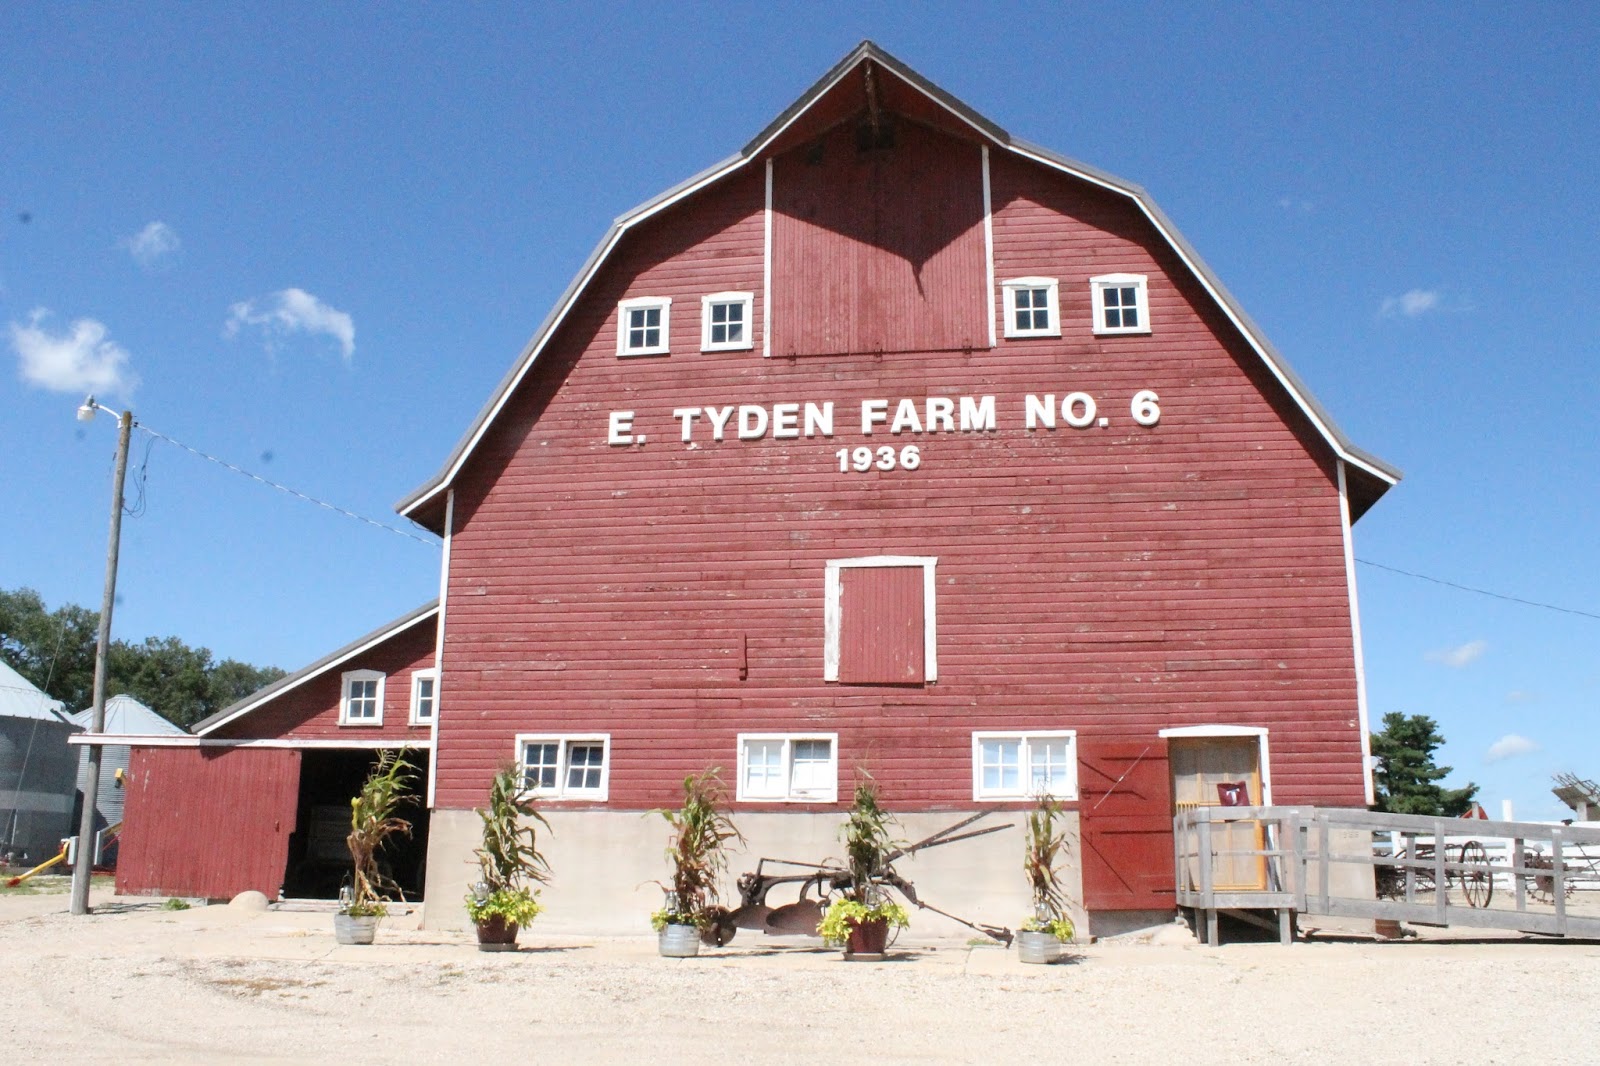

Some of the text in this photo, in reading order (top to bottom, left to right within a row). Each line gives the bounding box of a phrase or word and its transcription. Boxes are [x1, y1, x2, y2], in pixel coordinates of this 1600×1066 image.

[607, 388, 1162, 446] E. TYDEN FARM NO. 6
[835, 444, 922, 474] 1936
